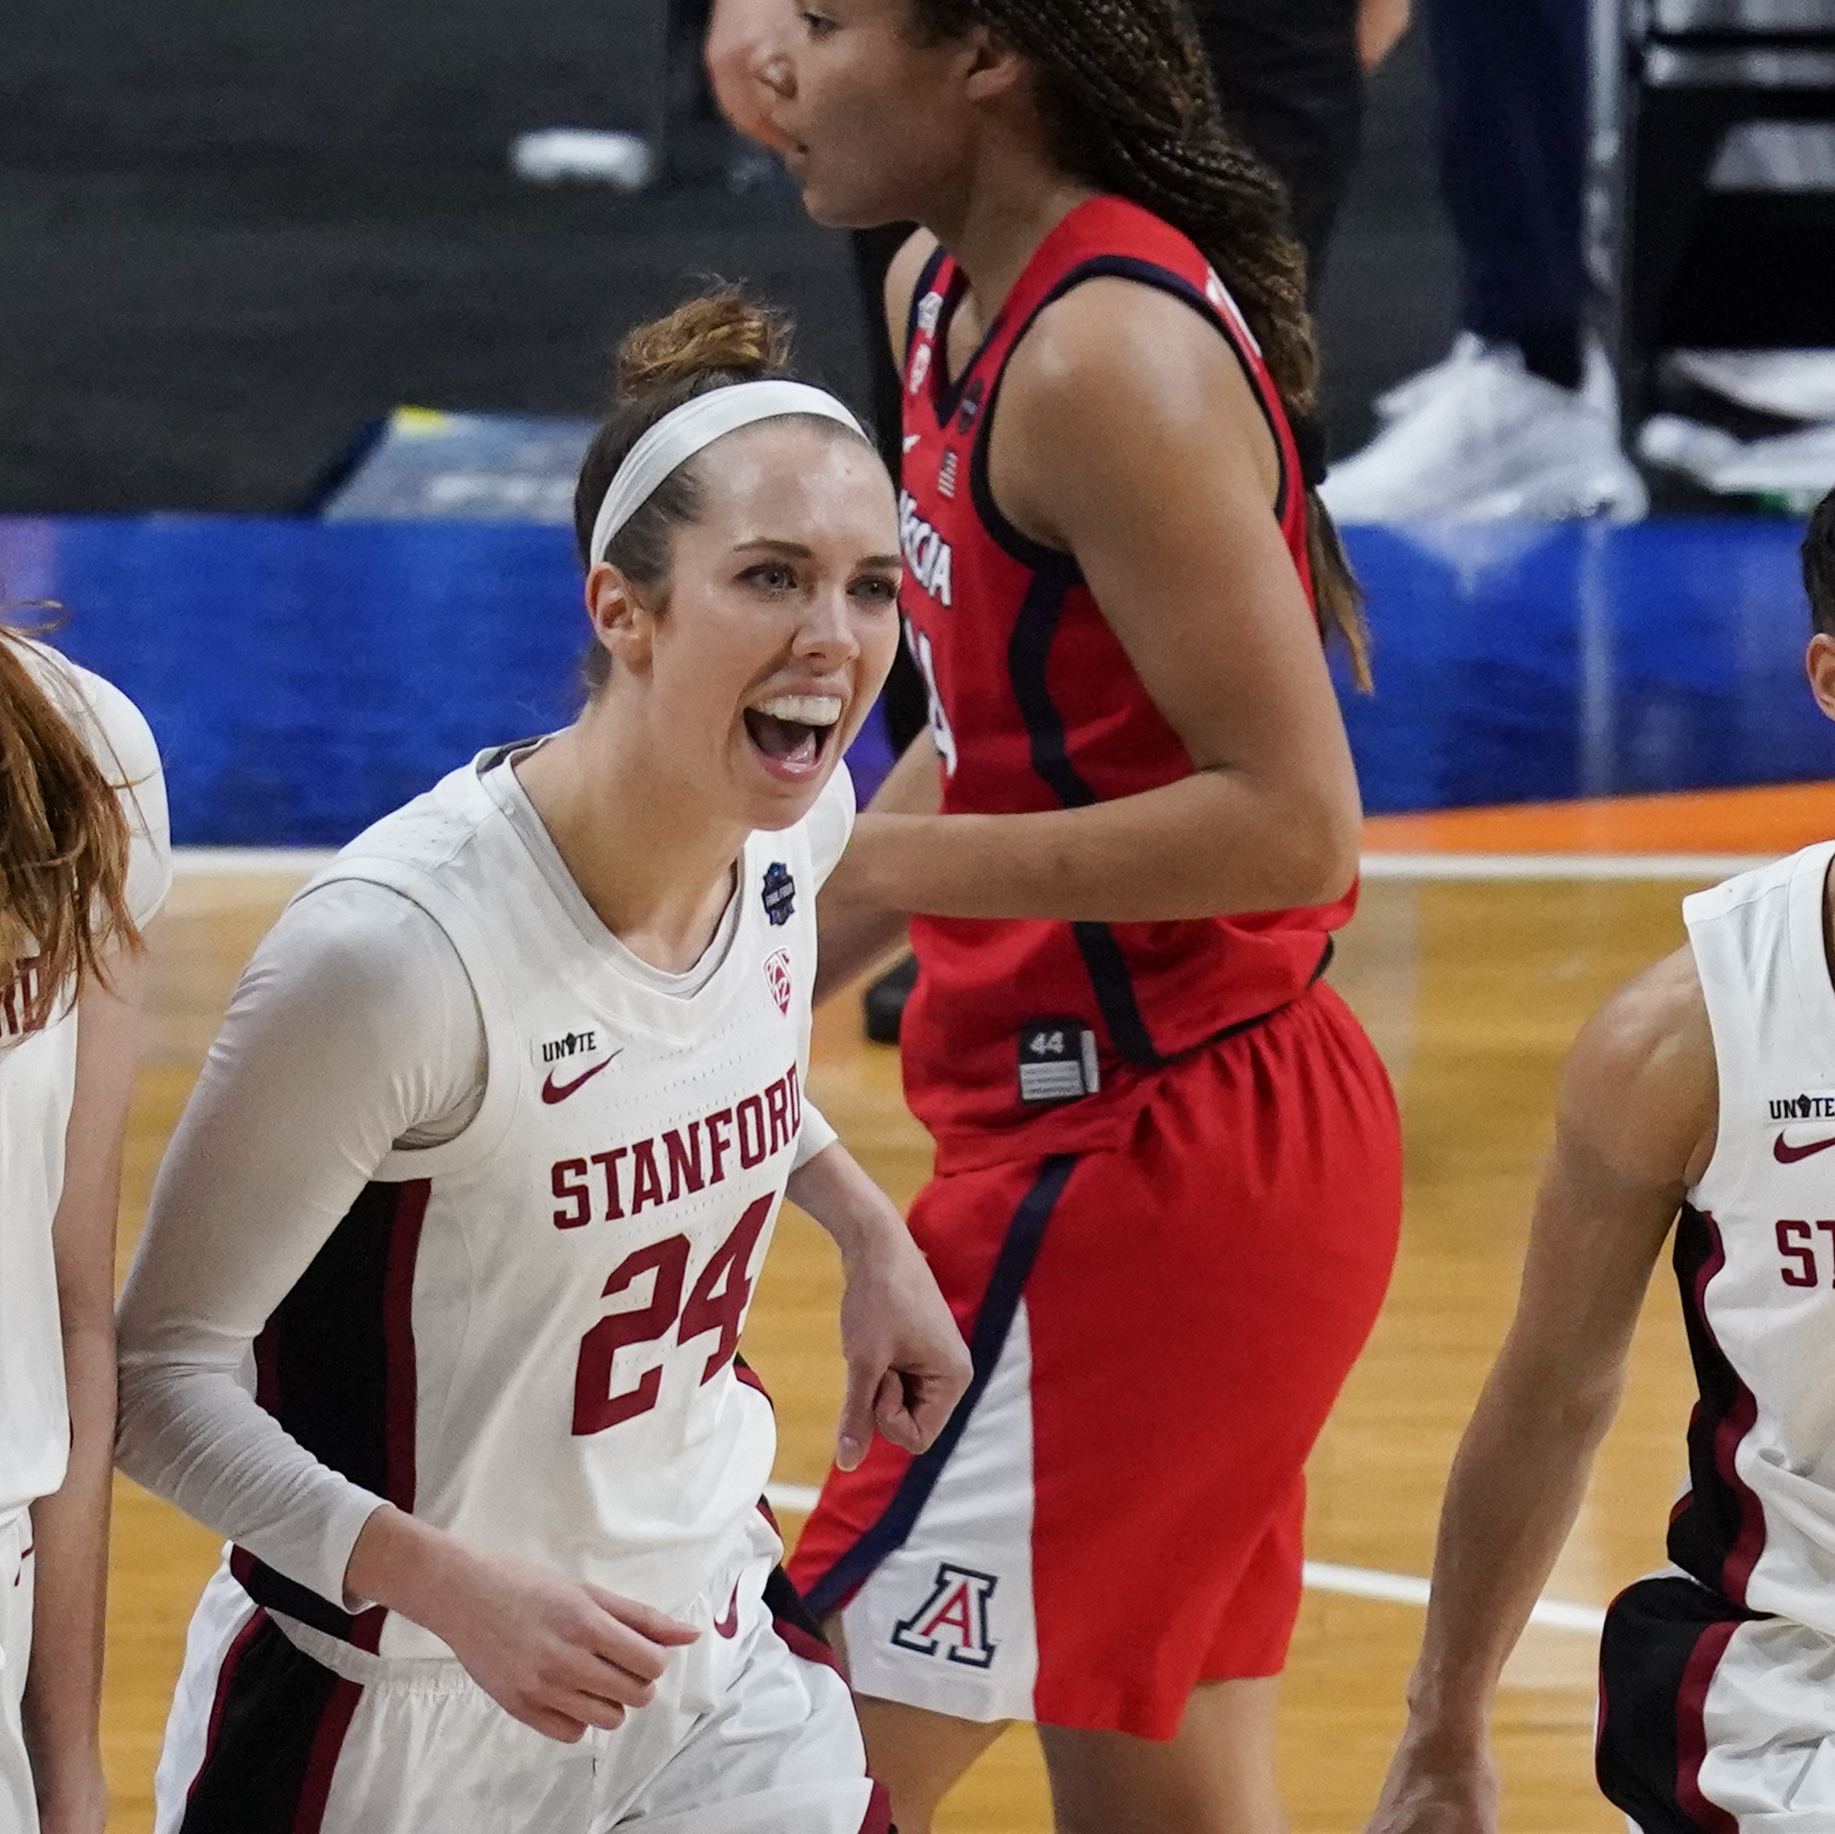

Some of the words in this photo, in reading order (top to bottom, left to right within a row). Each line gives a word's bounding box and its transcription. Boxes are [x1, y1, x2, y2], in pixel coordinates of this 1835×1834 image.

[1030, 1030, 1065, 1057] 44
[551, 1062, 801, 1230] STANFORD
[571, 1190, 777, 1437] 24
[891, 1562, 998, 1669] A
